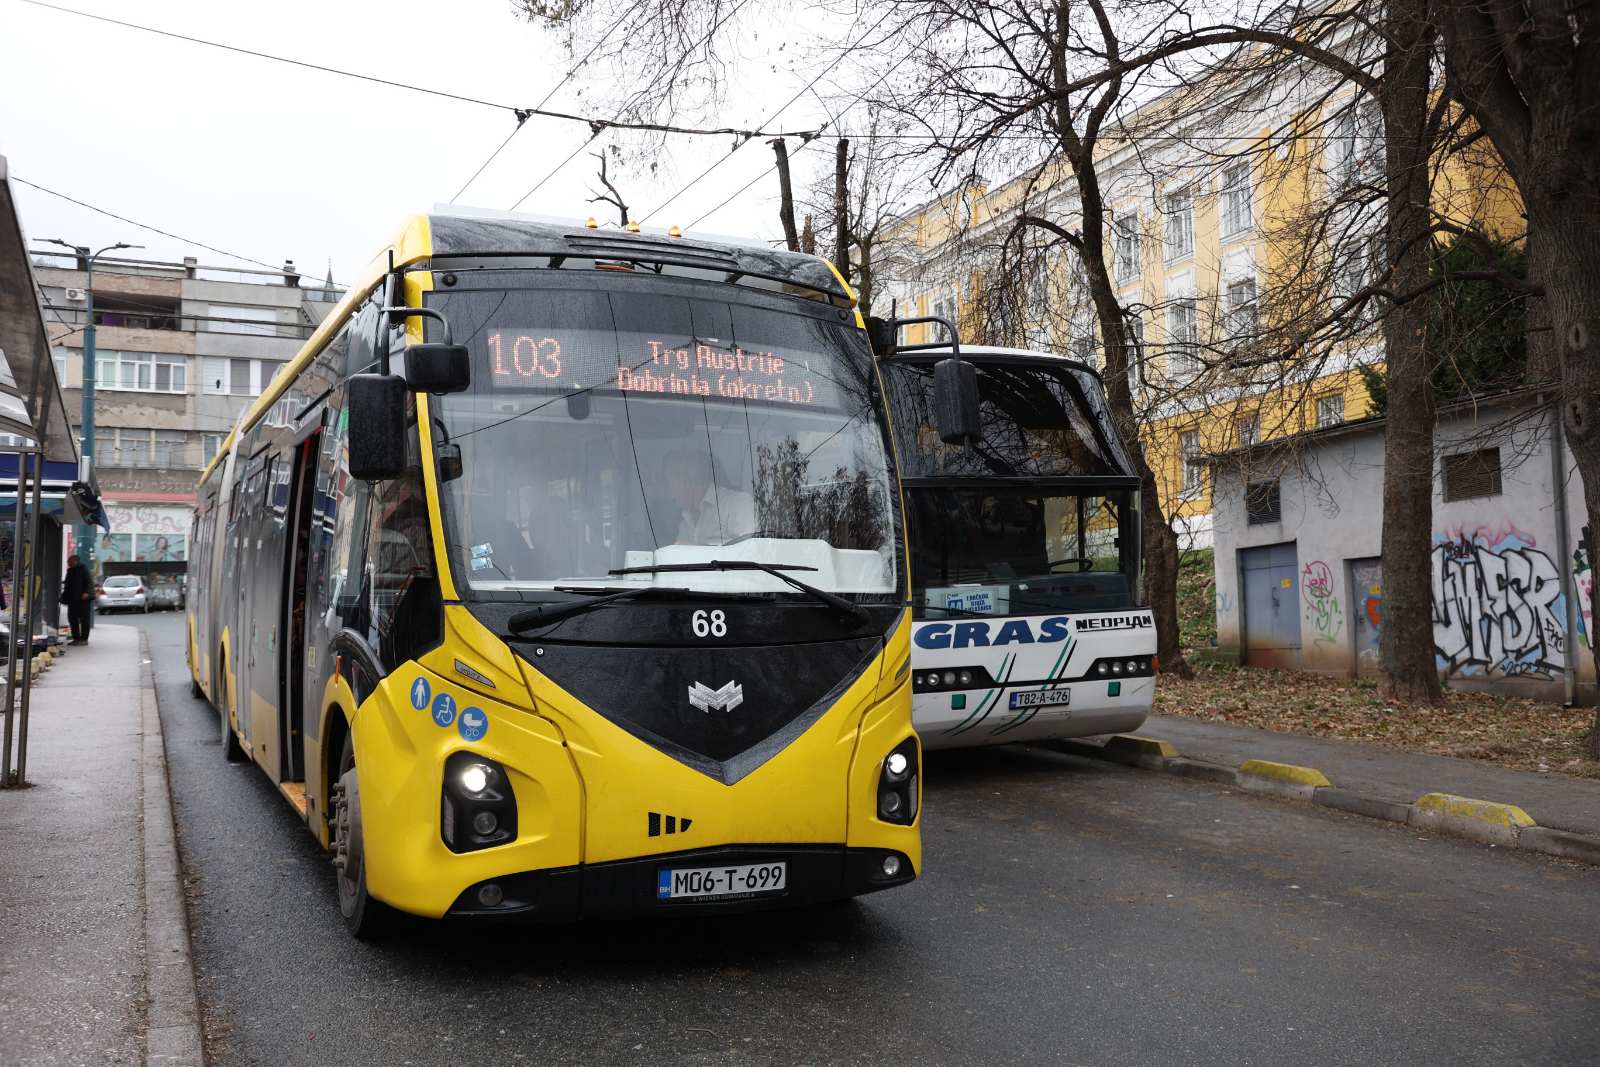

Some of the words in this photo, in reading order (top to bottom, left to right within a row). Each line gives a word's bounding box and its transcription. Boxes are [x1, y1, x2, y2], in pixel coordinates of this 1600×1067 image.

[487, 334, 561, 378] 103
[647, 341, 689, 370] Trg
[697, 345, 785, 375] Austrije
[617, 367, 710, 397] Dobrinja
[692, 609, 727, 638] 68
[913, 616, 1070, 650] GRAS
[1076, 615, 1152, 632] NEOPLAN
[1018, 691, 1068, 705] T82-A-476
[674, 865, 783, 894] M06-T-699
